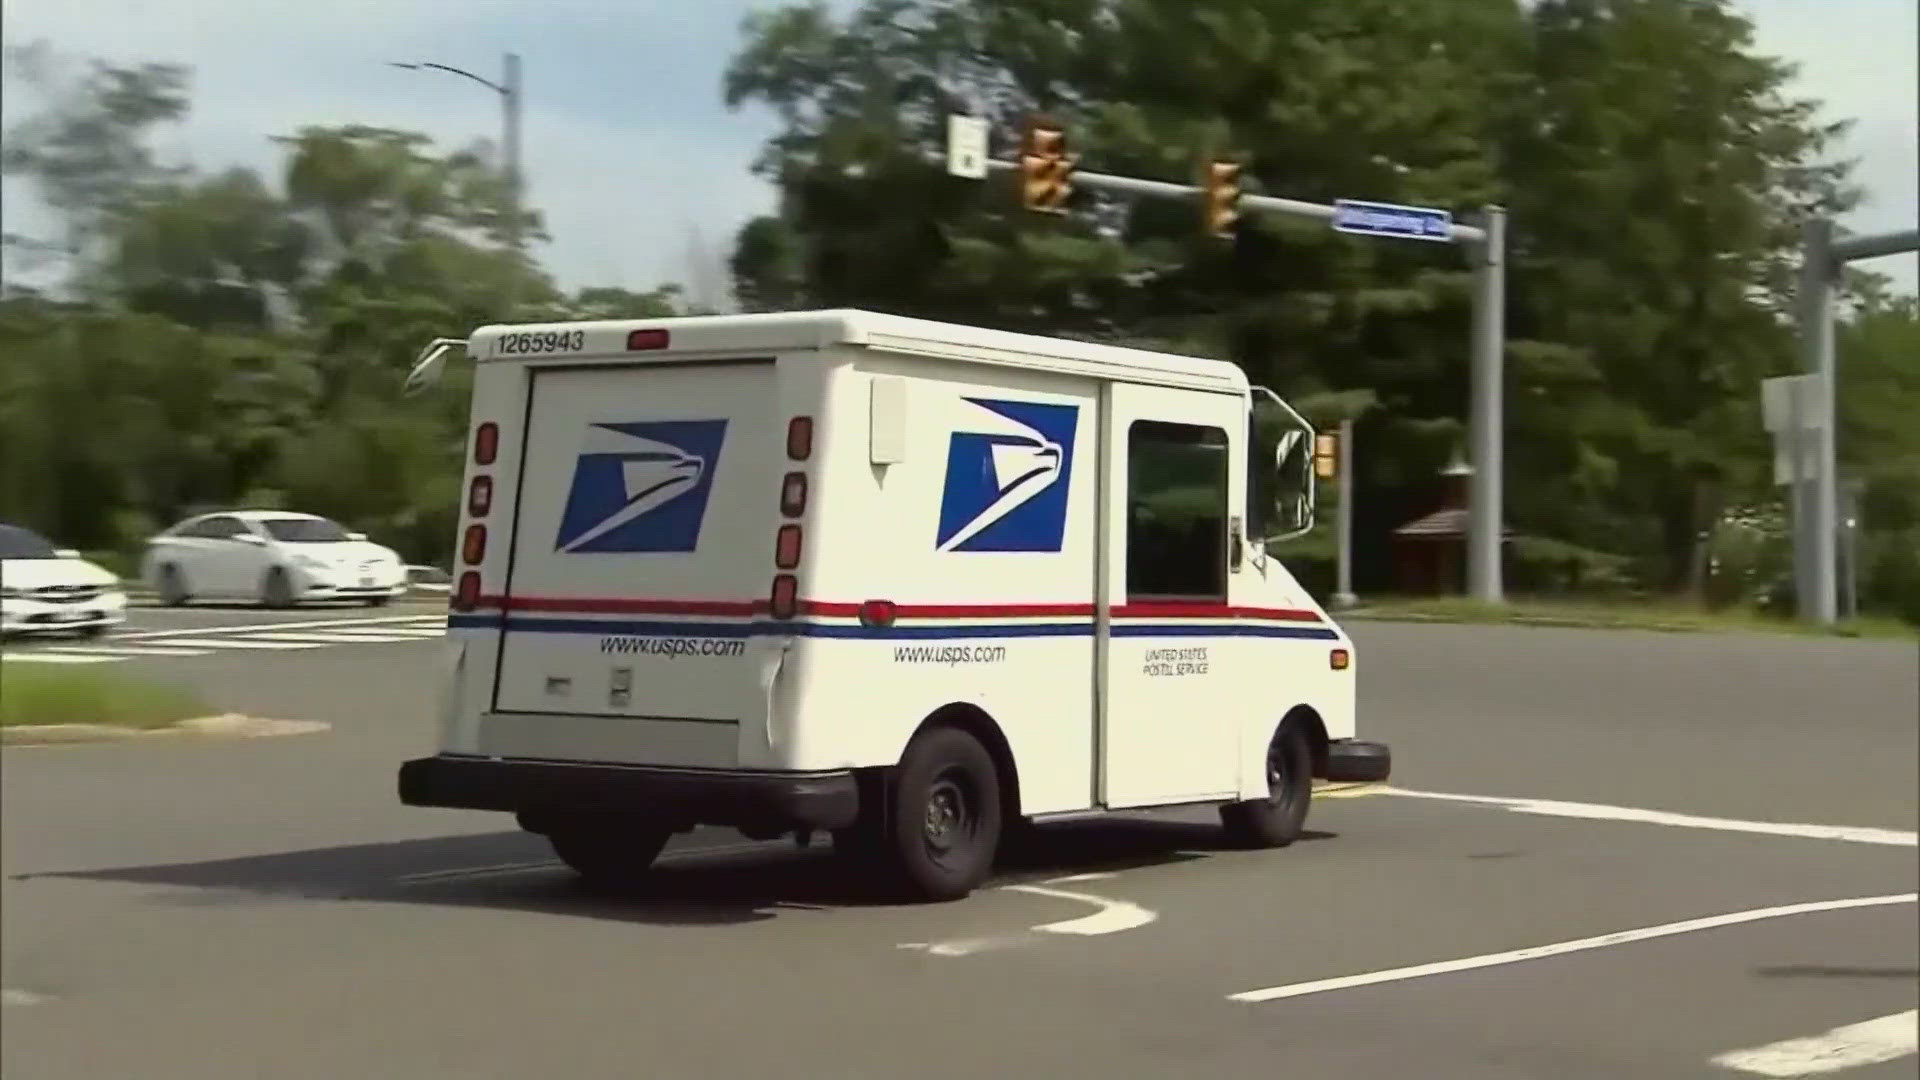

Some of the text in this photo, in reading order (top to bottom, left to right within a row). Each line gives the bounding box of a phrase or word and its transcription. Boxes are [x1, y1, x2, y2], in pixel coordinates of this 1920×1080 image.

[497, 331, 584, 353] 1265943
[600, 636, 745, 659] www.usps.com
[894, 645, 1006, 667] www.usps.com
[1145, 647, 1208, 661] UNITED STATES
[1176, 663, 1209, 676] SERVICE
